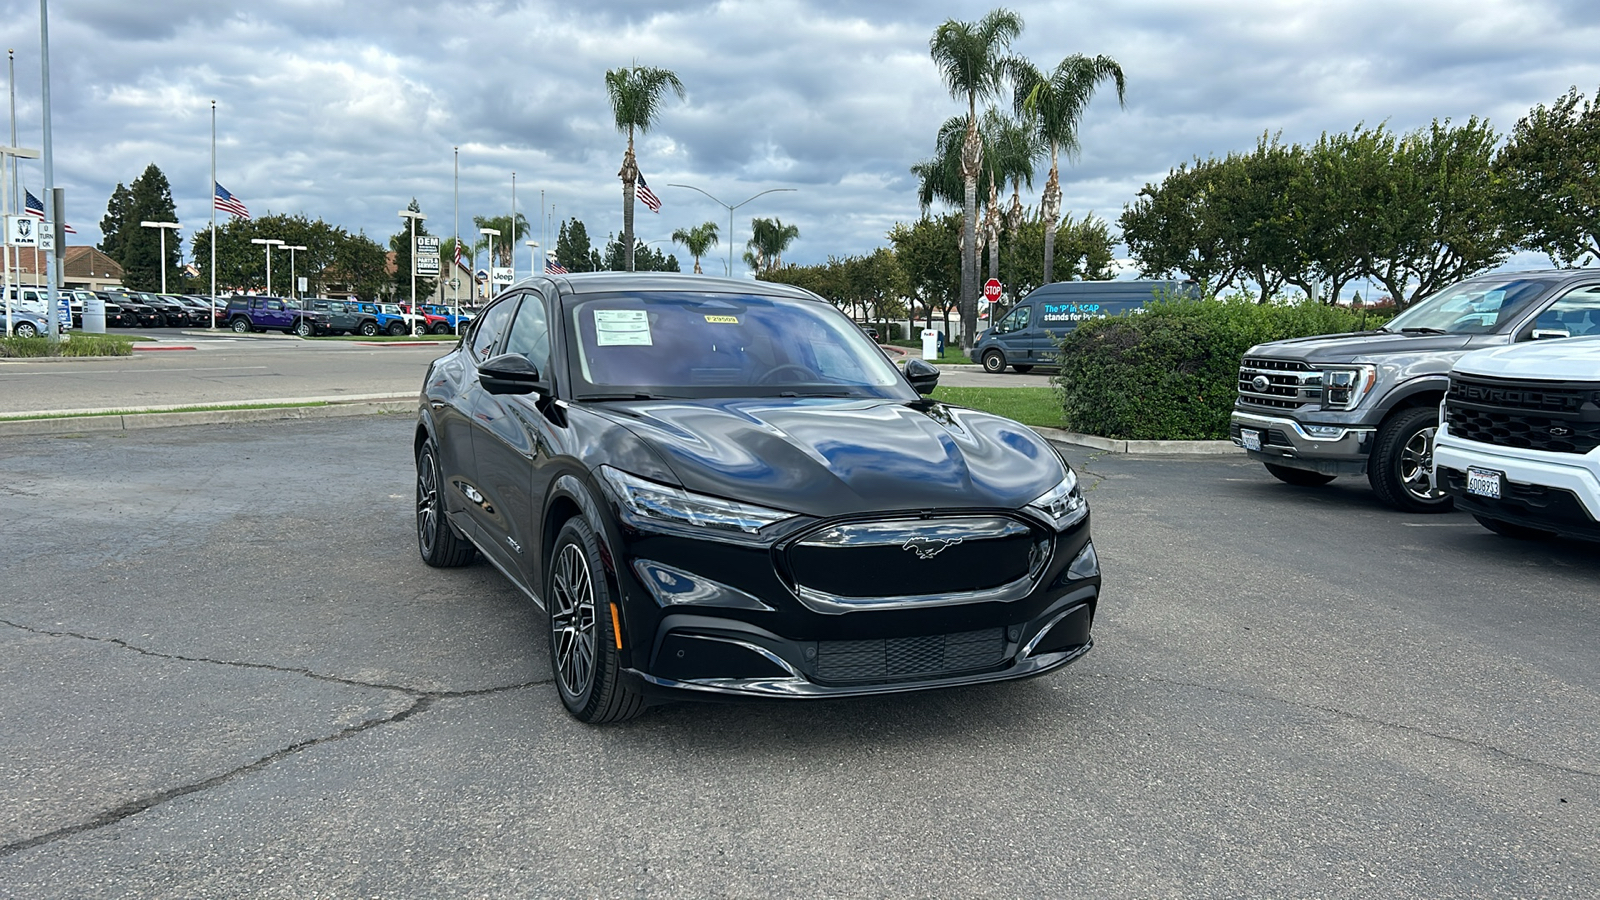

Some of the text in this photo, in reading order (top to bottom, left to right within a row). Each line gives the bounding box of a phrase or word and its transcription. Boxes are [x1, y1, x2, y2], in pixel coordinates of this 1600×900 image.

[417, 238, 438, 246] OEM
[494, 273, 513, 281] Jeep
[985, 286, 1000, 295] STOP
[1044, 313, 1069, 321] stands
[1450, 384, 1583, 405] CHEVROLET
